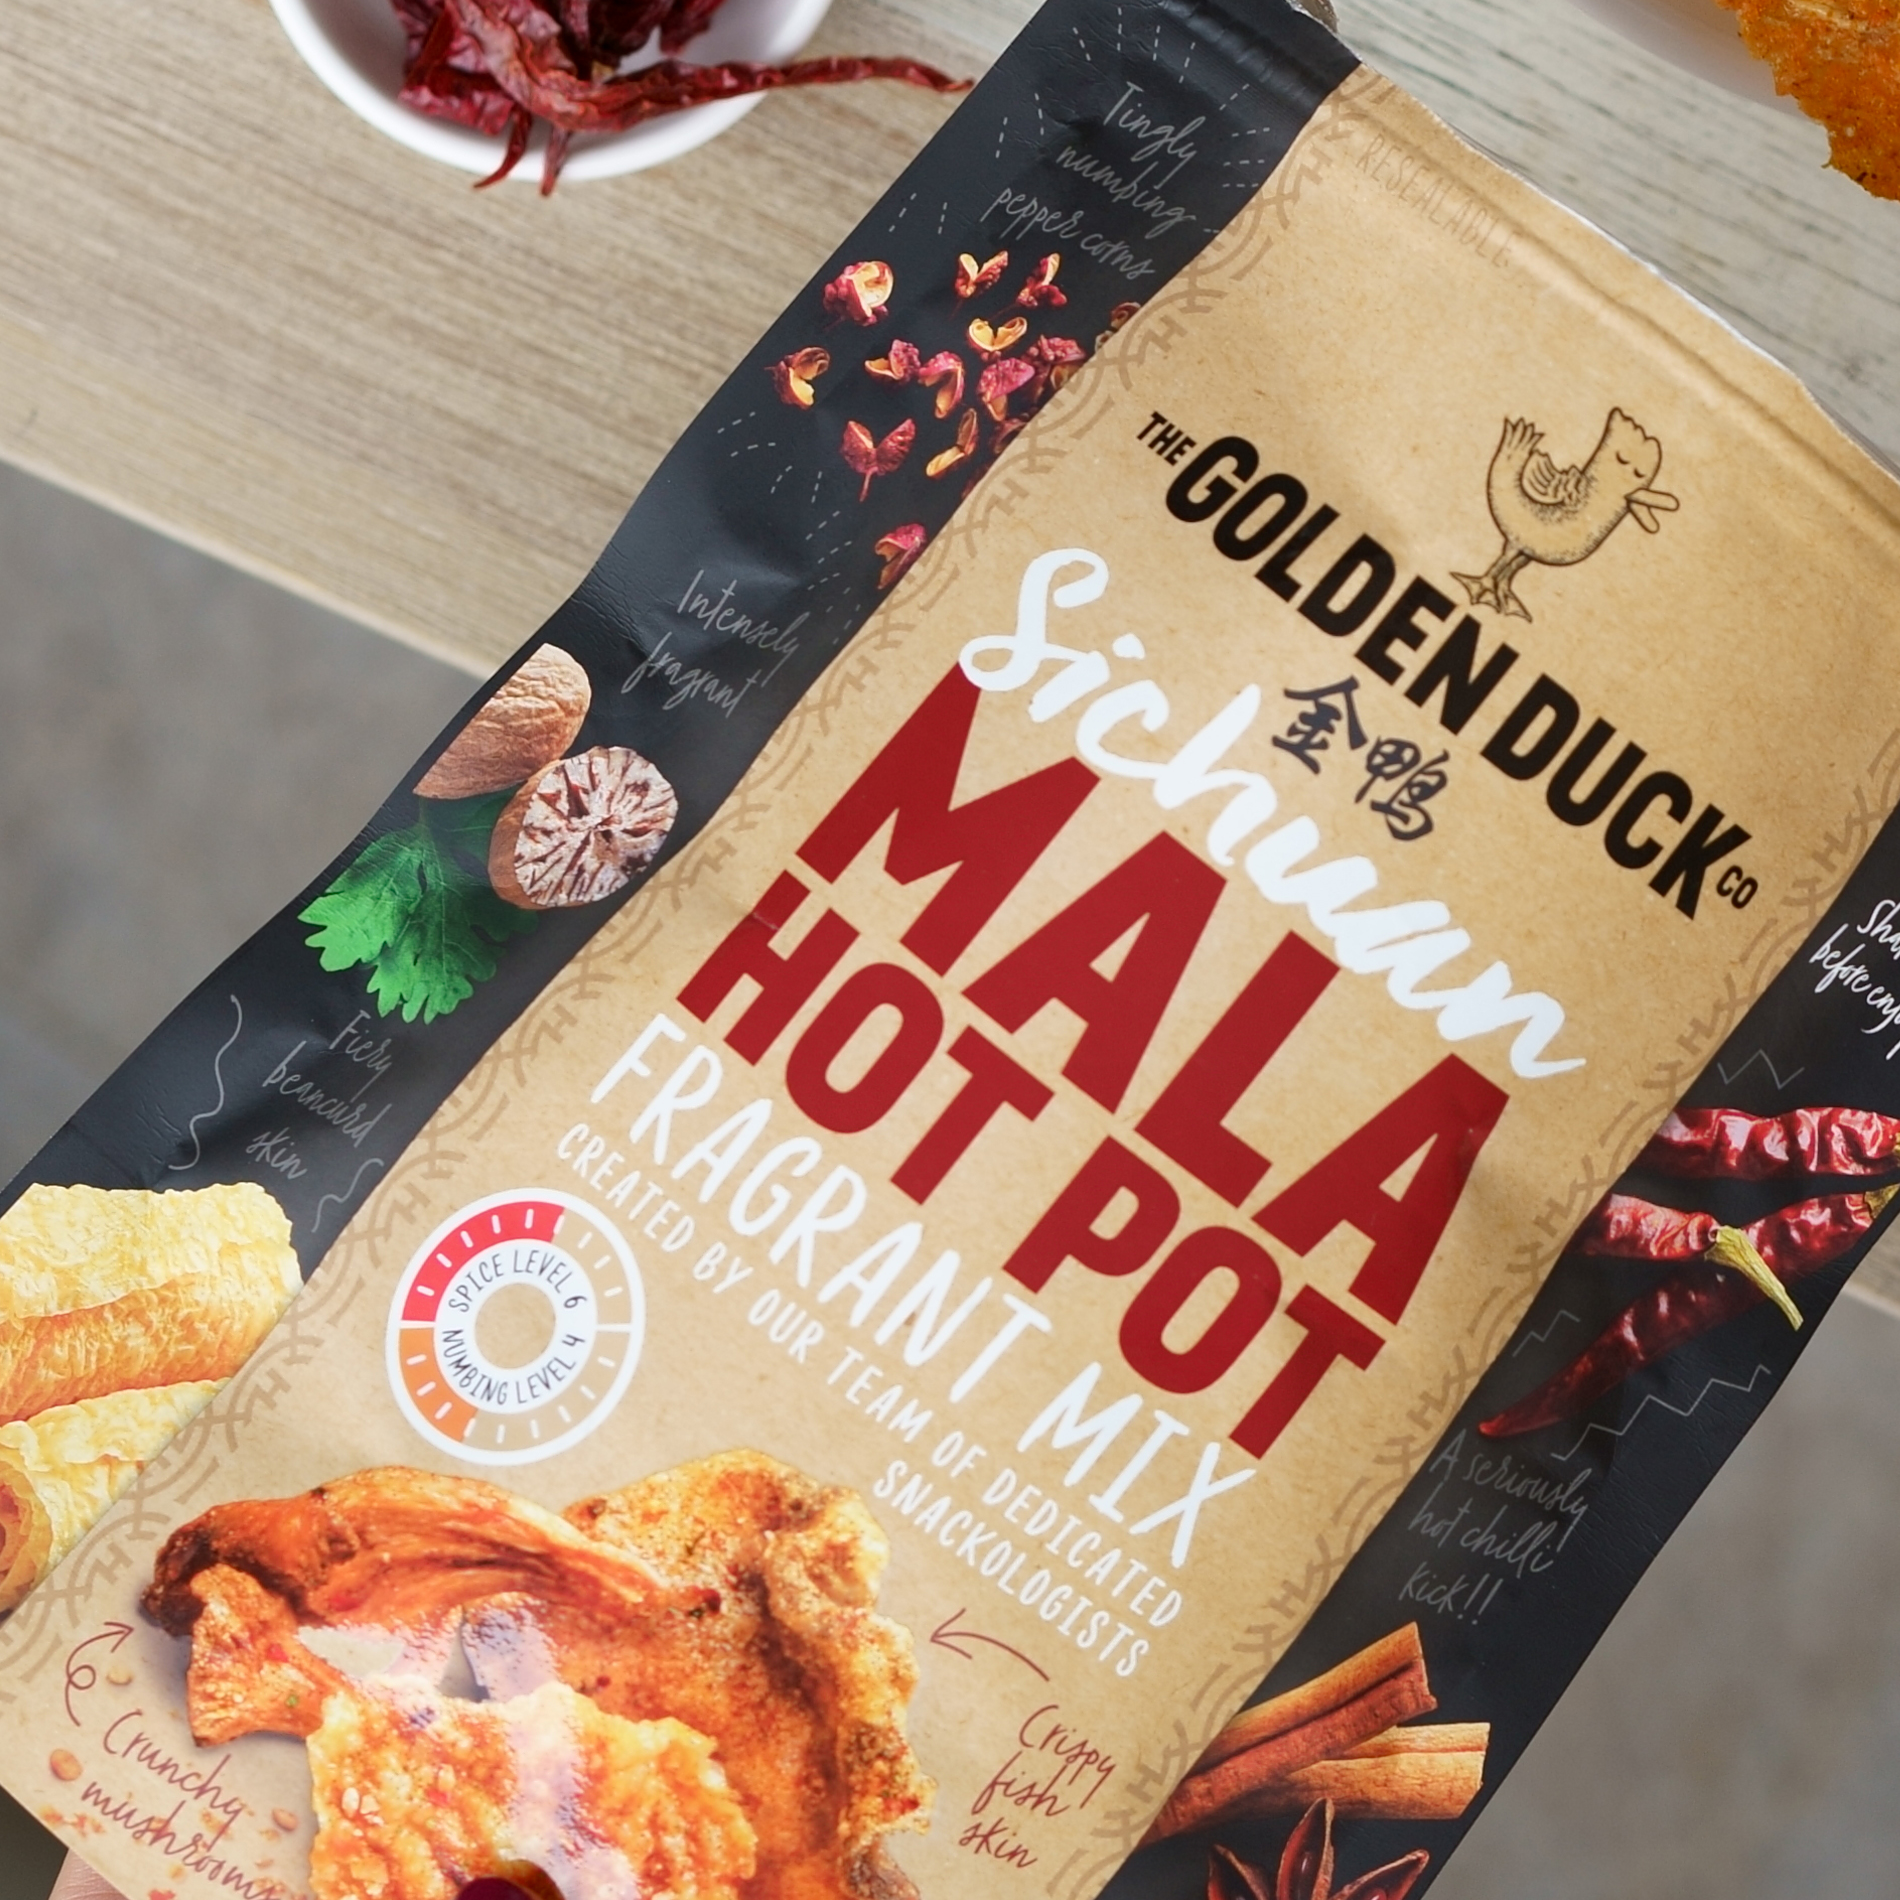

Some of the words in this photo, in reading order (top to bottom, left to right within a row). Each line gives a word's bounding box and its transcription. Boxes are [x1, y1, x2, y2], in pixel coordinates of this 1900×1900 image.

[1103, 81, 1206, 190] Tingly
[1056, 146, 1197, 239] numbing
[1355, 133, 1512, 268] RESEALABLE
[1135, 410, 1197, 466] THE
[676, 569, 811, 688] Intensely
[1164, 434, 1521, 736] GOLDEN
[620, 631, 762, 718] fragrant
[958, 547, 1586, 1079] Sichuan
[1479, 672, 1753, 922] DUCK
[1715, 864, 1759, 909] CO
[794, 660, 1511, 1326] MALA
[1809, 923, 1872, 993] before
[261, 1040, 393, 1148] beancurd
[328, 1009, 392, 1103] Fiery
[245, 1127, 308, 1180] skin
[675, 868, 1055, 1206] HOT
[1001, 1134, 1387, 1460] POT
[448, 1252, 505, 1313] SPICE
[512, 1249, 573, 1294] LEVEL
[563, 1294, 588, 1309] 6
[590, 1013, 1053, 1403] FRAGRANT
[1016, 1362, 1257, 1569] MIX
[441, 1328, 509, 1406] NUMBING
[515, 1356, 577, 1404] LEVEL
[561, 1333, 586, 1348] 4
[557, 1122, 696, 1253] CREATED
[693, 1241, 754, 1295] BY
[747, 1288, 825, 1365] OUR
[826, 1346, 934, 1444] TEAM
[931, 1430, 988, 1479] OF
[981, 1467, 1183, 1627] DEDICATED
[1407, 1481, 1474, 1549] hot
[1459, 1504, 1558, 1580] chilli
[1429, 1428, 1467, 1482] A
[1461, 1452, 1593, 1553] seriously
[872, 1459, 1150, 1677] SNACKOLOGISTS
[102, 1708, 244, 1852] Crunchy
[971, 1750, 1071, 1817] fish
[1018, 1704, 1117, 1810] Crispy
[958, 1816, 1039, 1868] skin
